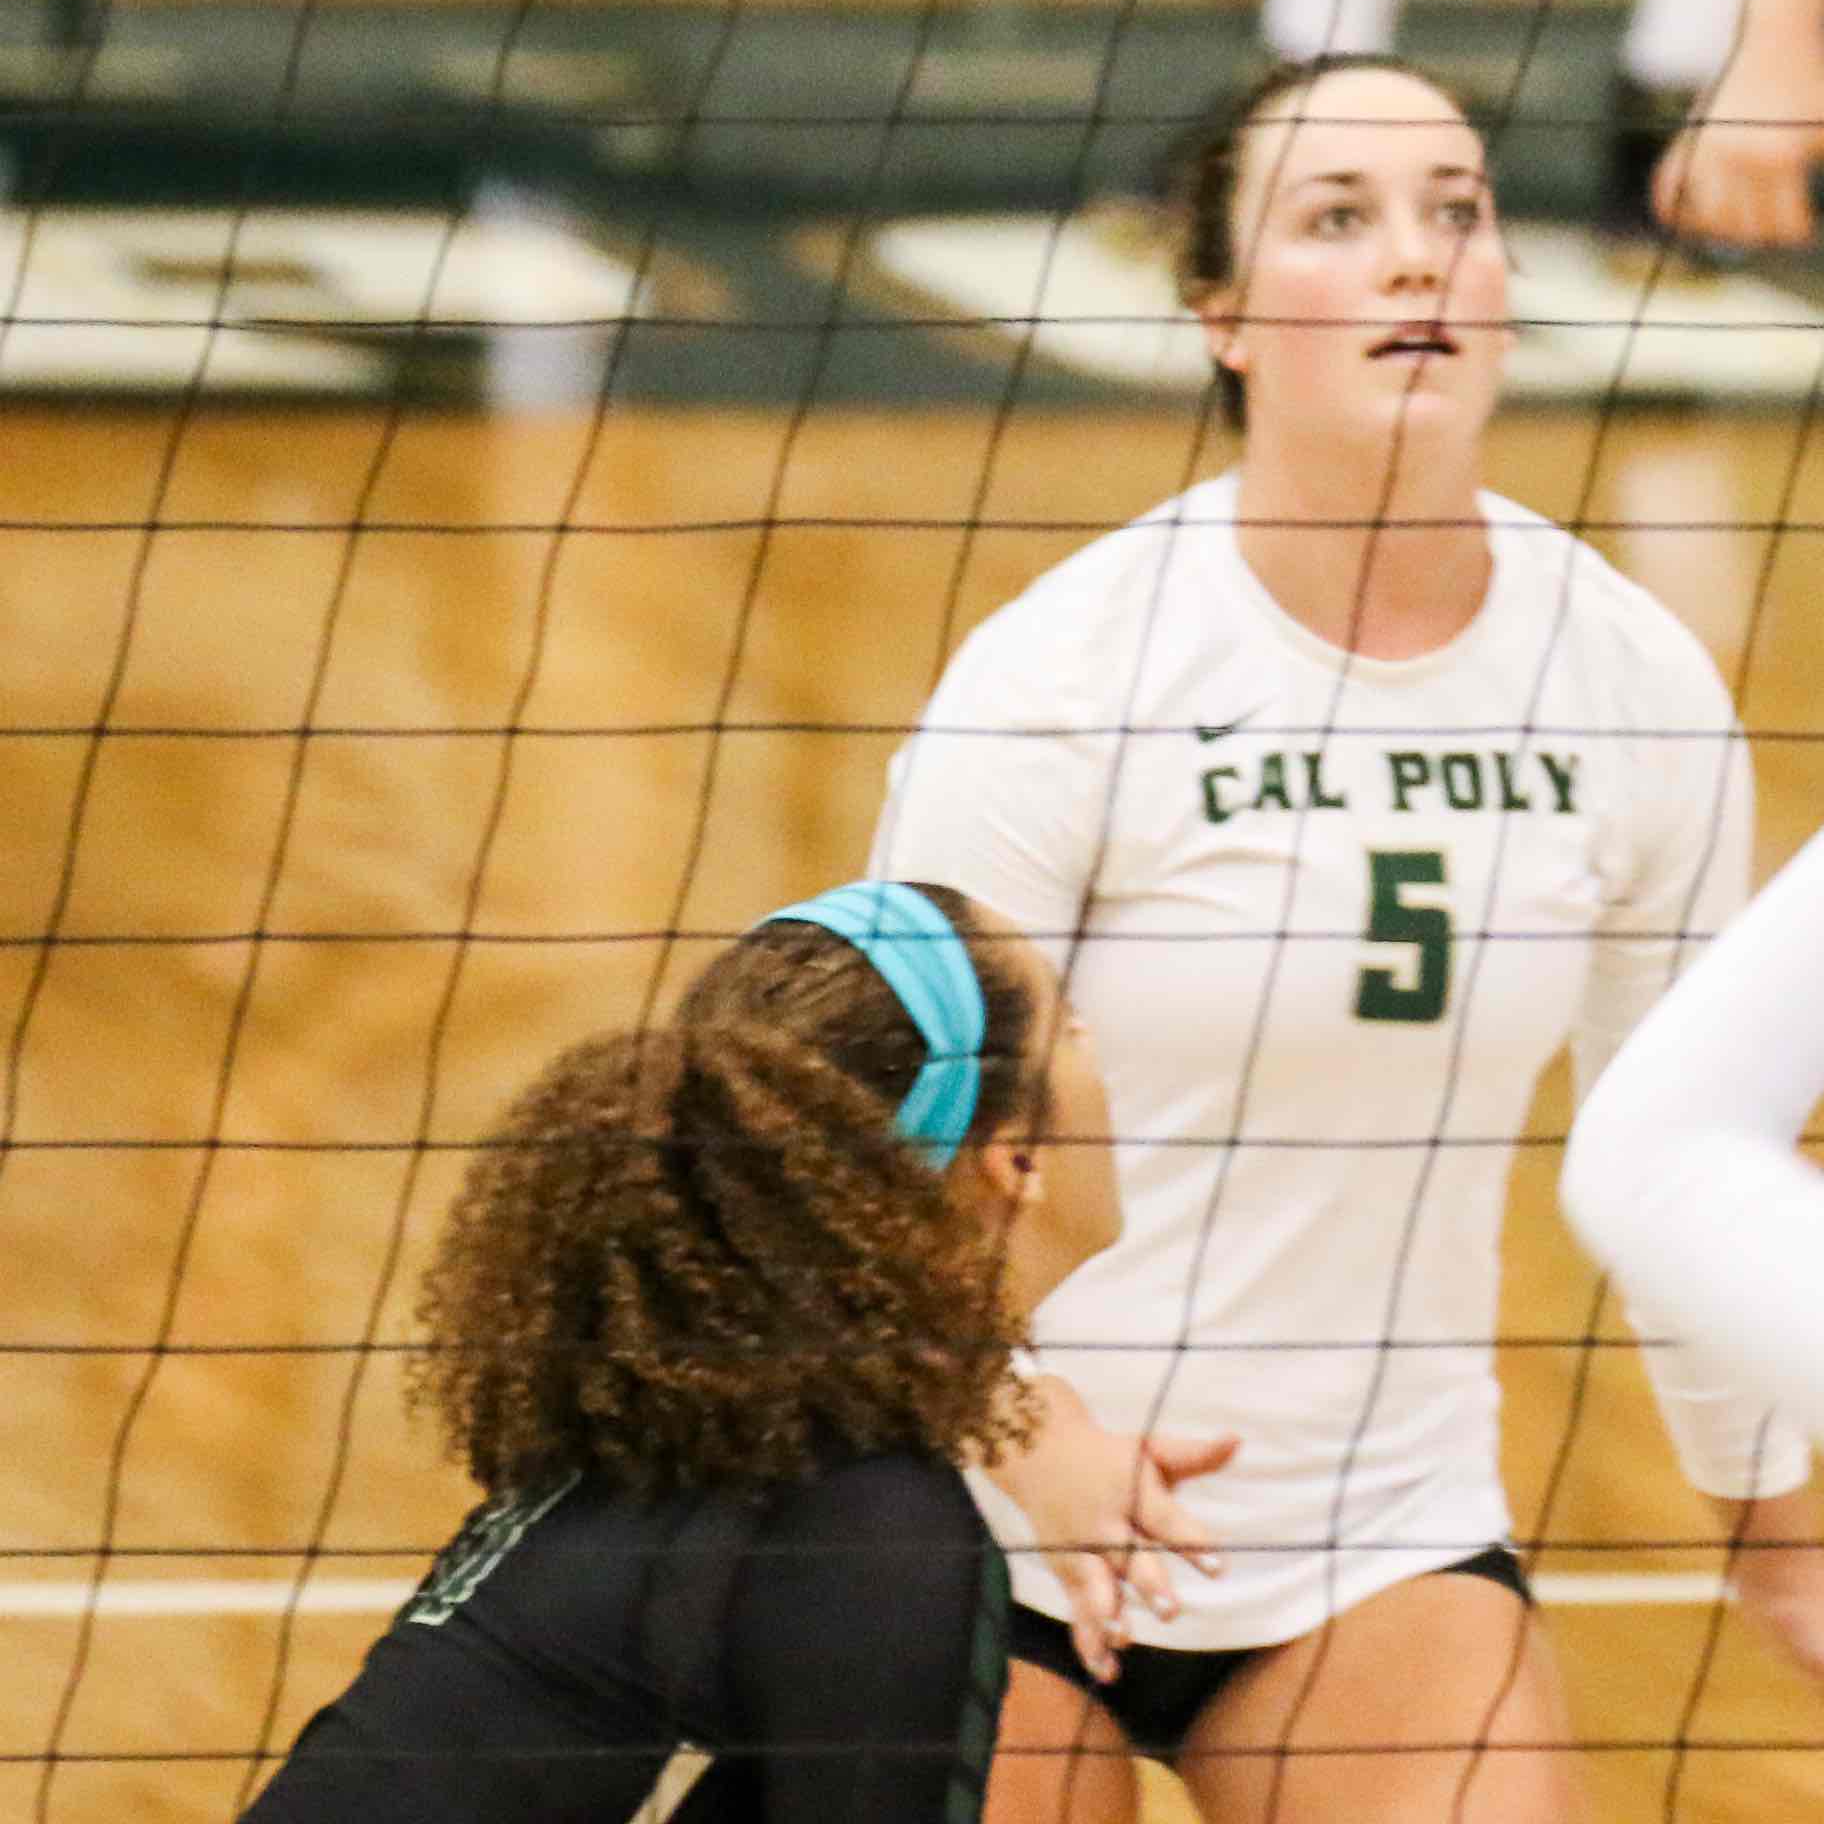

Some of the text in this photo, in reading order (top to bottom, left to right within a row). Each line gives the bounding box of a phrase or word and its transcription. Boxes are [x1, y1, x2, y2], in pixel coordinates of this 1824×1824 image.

[1200, 751, 1579, 824] CAL POLY
[1352, 850, 1453, 1024] 5
